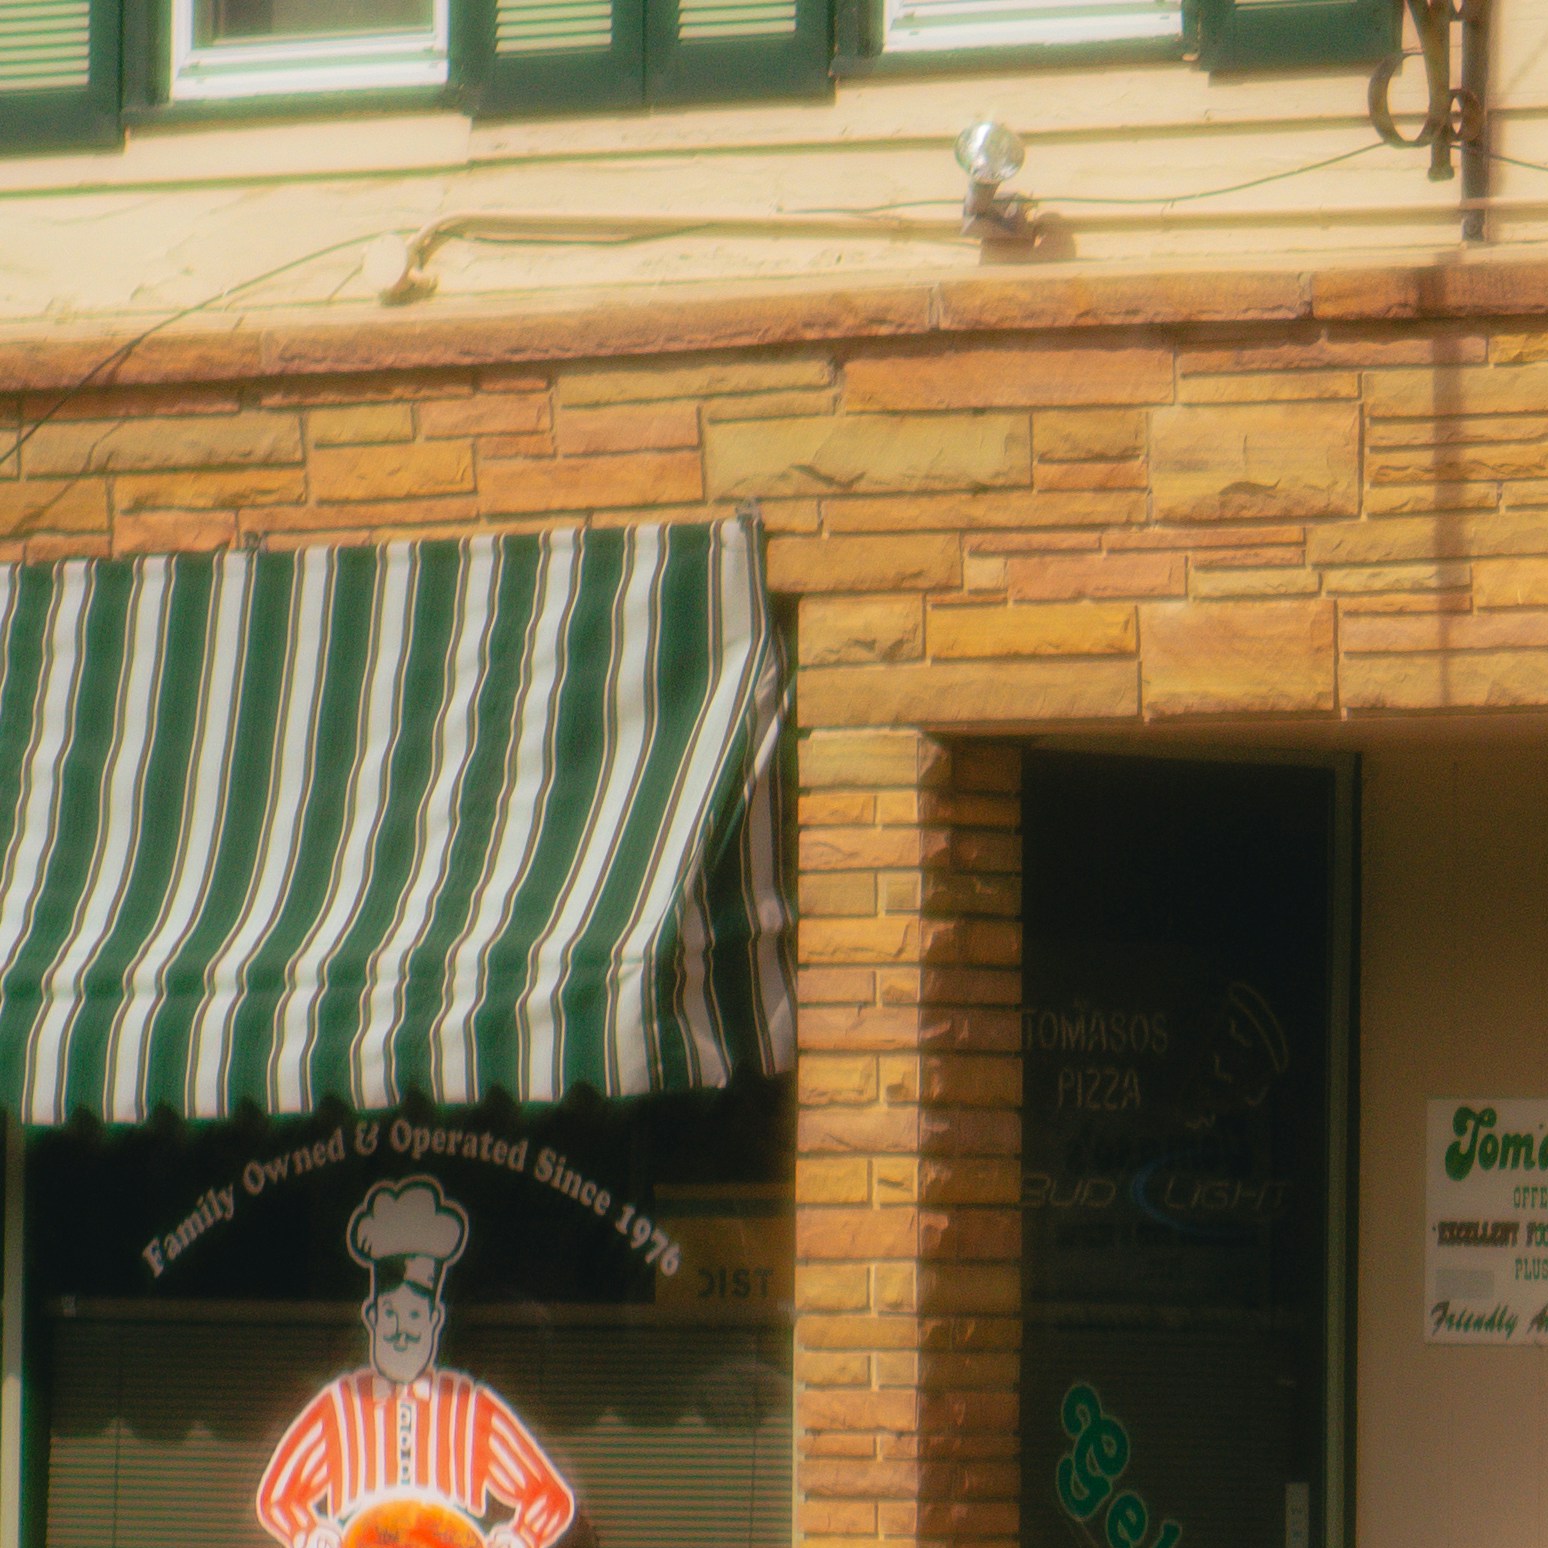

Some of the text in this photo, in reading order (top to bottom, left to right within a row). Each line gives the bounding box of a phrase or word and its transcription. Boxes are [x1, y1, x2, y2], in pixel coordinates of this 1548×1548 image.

[1058, 1067, 1142, 1110] PIZZA
[141, 1119, 680, 1278] Family Owned & Operated Since 1976
[1438, 1221, 1520, 1247] EXCELLENT
[1430, 1301, 1519, 1340] Friendly
